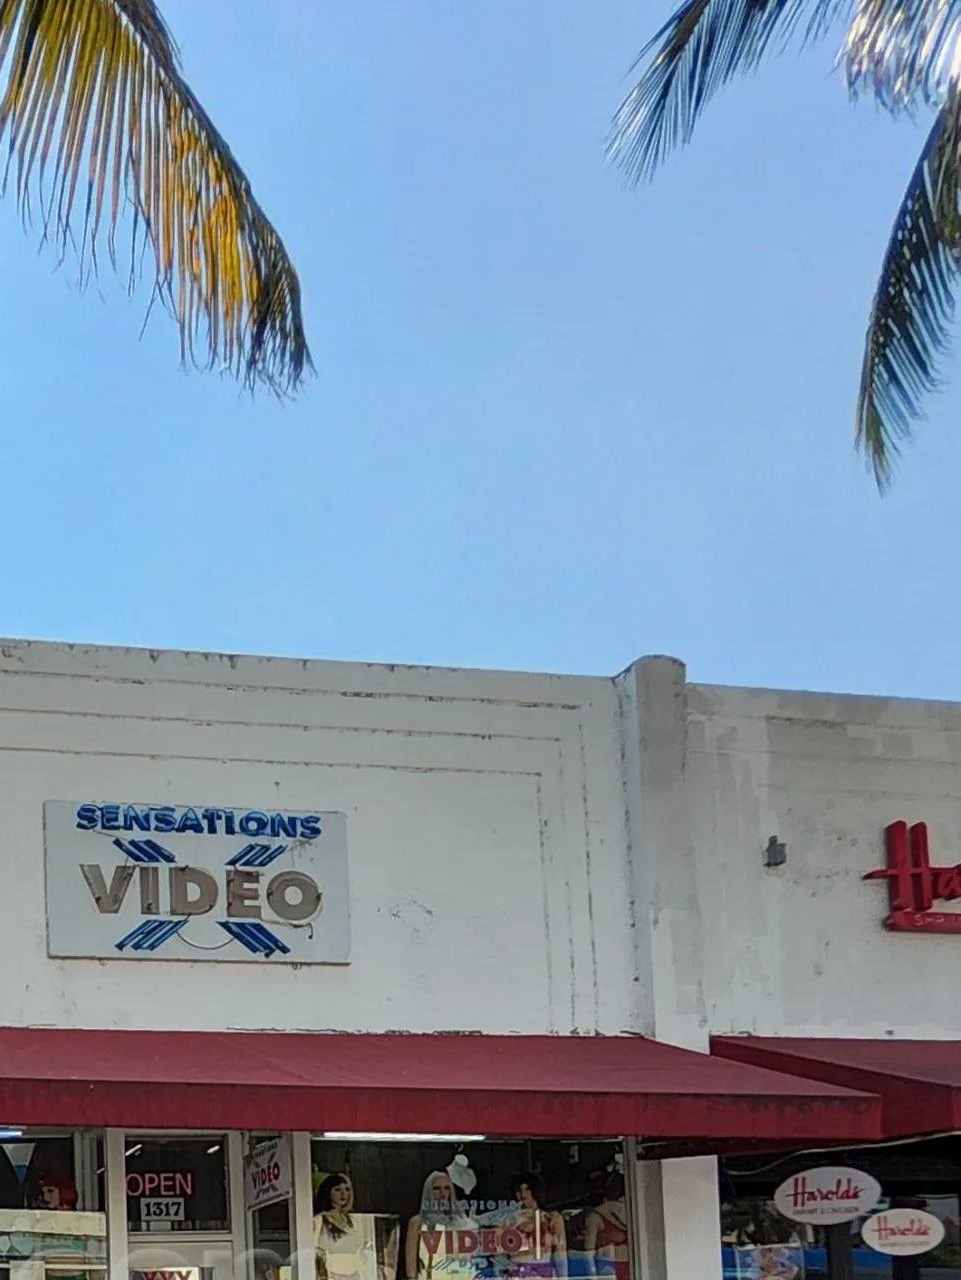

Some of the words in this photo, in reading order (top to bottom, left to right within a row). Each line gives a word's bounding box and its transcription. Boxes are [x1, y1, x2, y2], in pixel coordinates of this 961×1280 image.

[76, 803, 322, 840] SENSATIONS
[79, 863, 324, 922] VIDEO
[125, 1172, 193, 1197] OPEN
[251, 1161, 281, 1190] VIDEO
[143, 1201, 183, 1218] 1317
[419, 1228, 524, 1255] VIDEO
